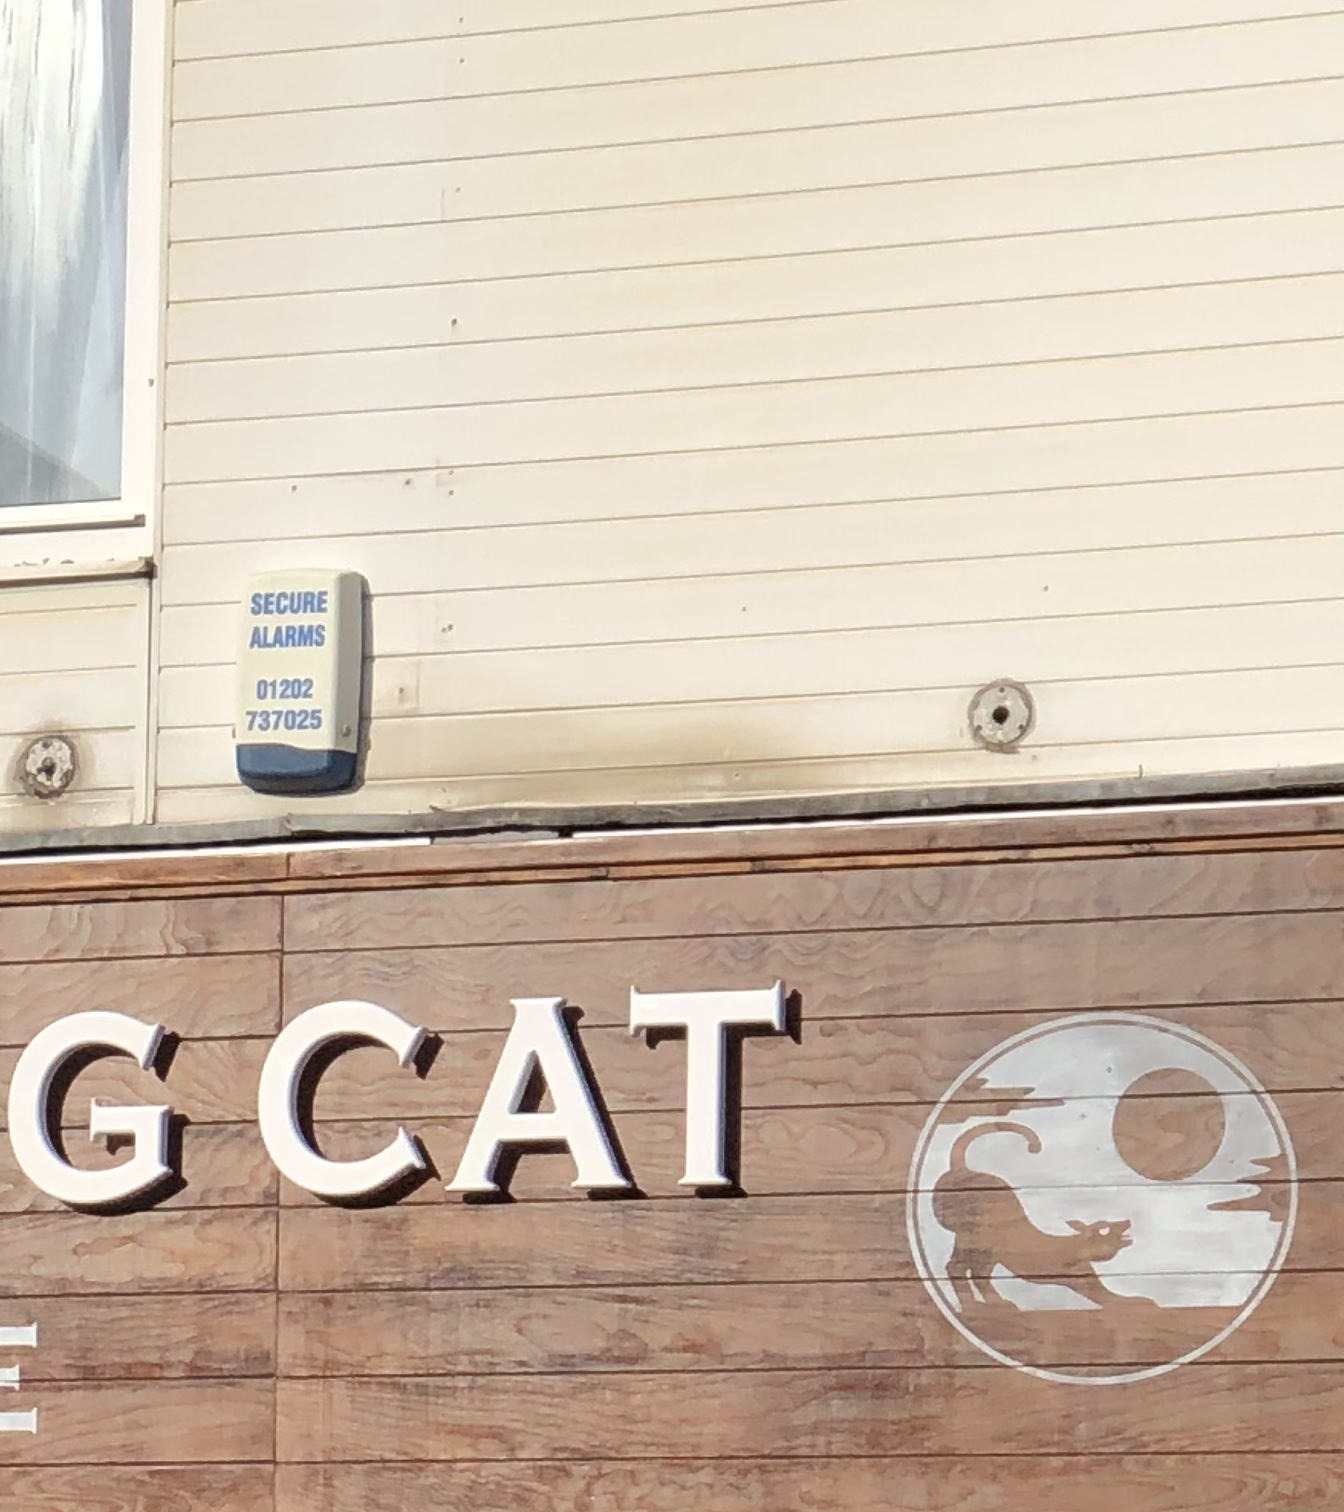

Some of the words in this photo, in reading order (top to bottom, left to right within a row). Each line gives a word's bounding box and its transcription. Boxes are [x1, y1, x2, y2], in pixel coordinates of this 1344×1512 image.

[251, 591, 328, 615] SECURE
[249, 624, 326, 649] ALARMS
[256, 679, 313, 700] 01202
[245, 709, 323, 731] 737025
[257, 980, 785, 1198] CAT
